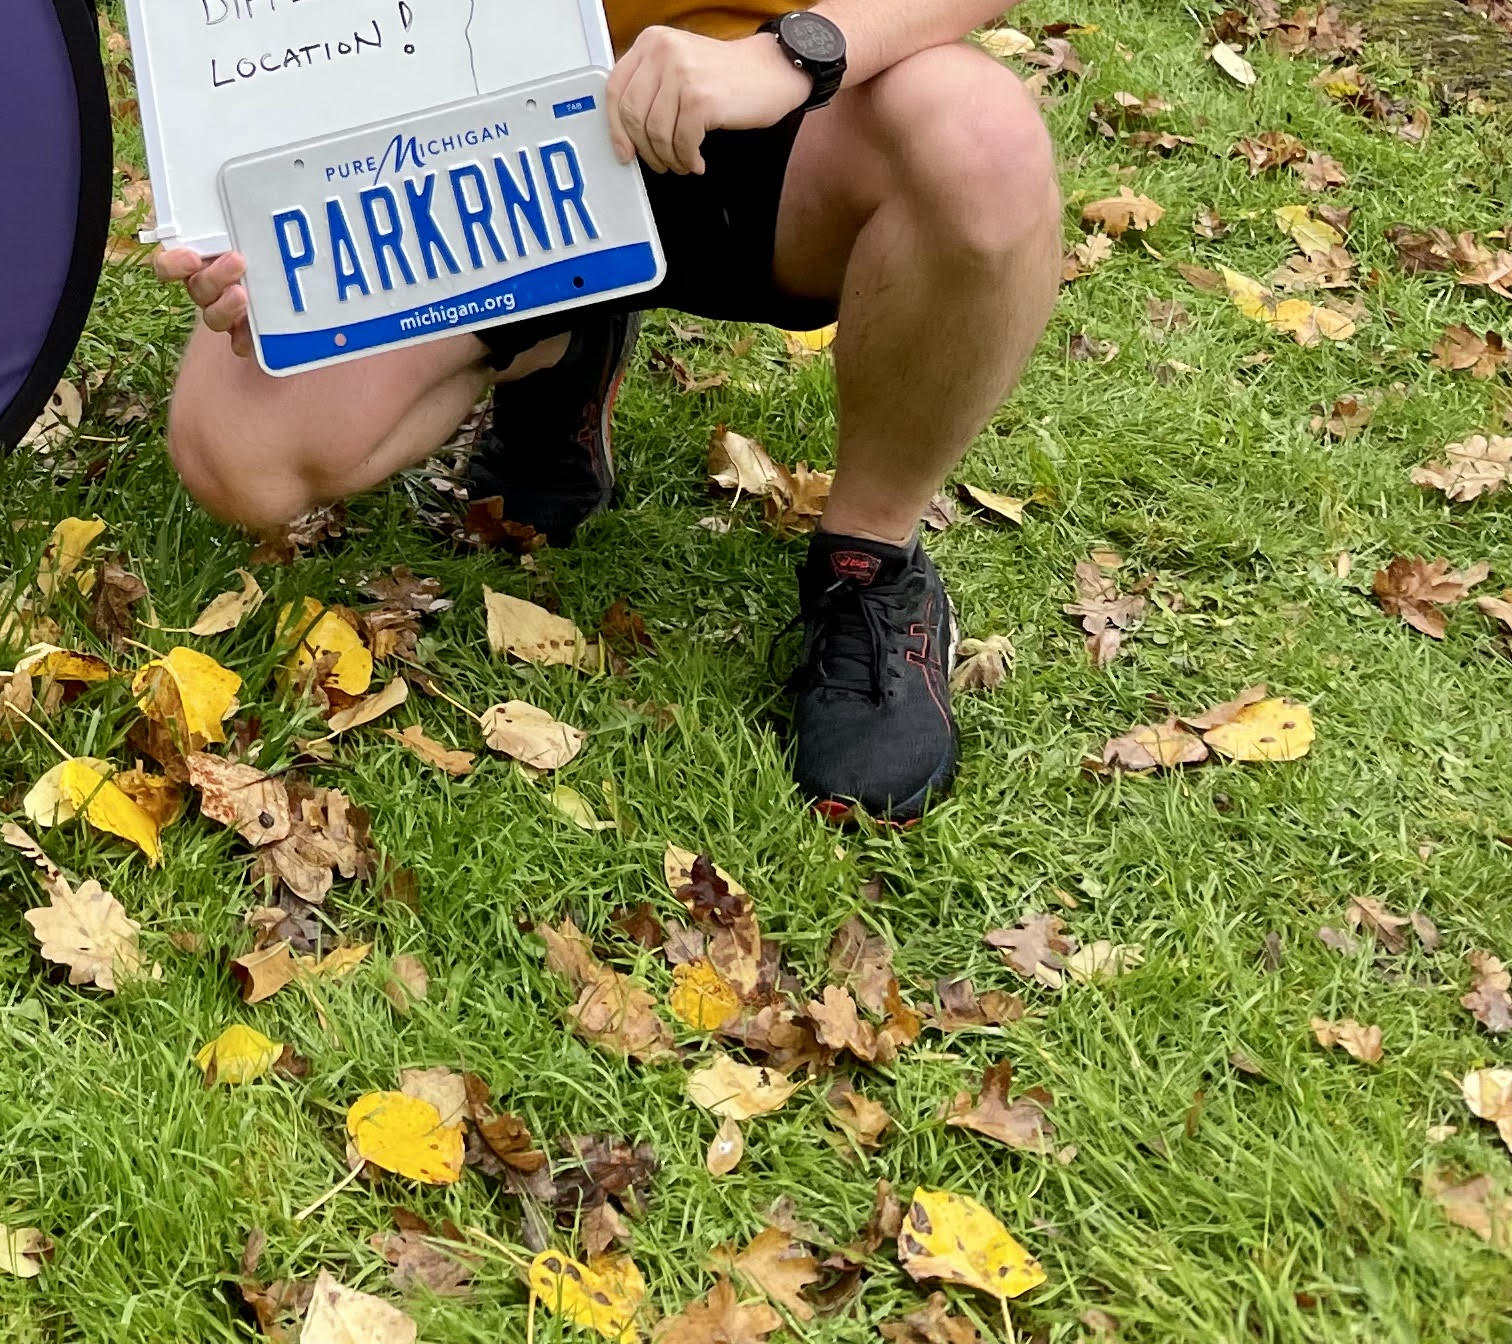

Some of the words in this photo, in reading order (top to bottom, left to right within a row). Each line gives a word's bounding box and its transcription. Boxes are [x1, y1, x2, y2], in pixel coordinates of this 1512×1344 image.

[325, 156, 378, 182] PURE
[374, 121, 510, 186] MICHIGAN
[272, 138, 601, 313] PARKRNR
[399, 292, 517, 331] michigan.org
